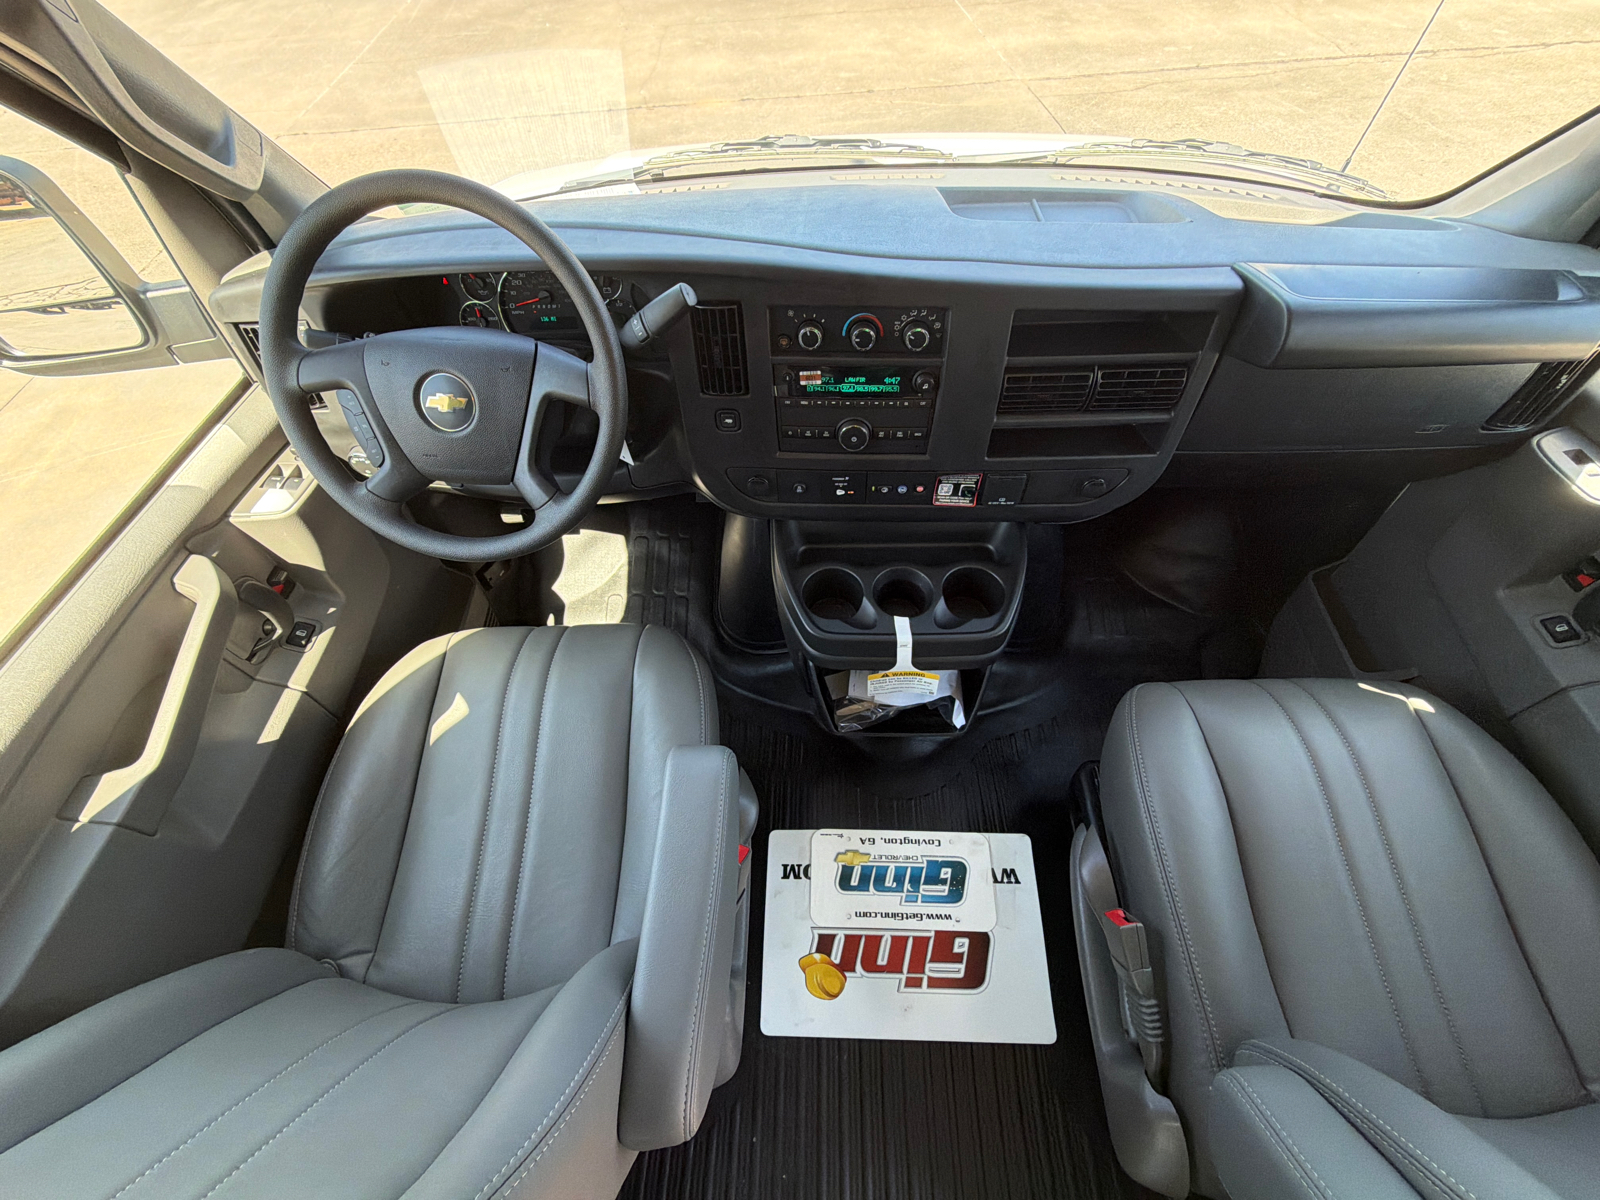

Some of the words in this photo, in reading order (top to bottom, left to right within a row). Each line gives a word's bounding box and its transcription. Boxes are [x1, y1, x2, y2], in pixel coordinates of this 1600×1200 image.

[859, 837, 876, 846] GA
[880, 836, 942, 847] Covington,
[835, 855, 969, 906] Ginn
[855, 910, 953, 921] www.GetGinn.com
[811, 928, 994, 993] Ginn
